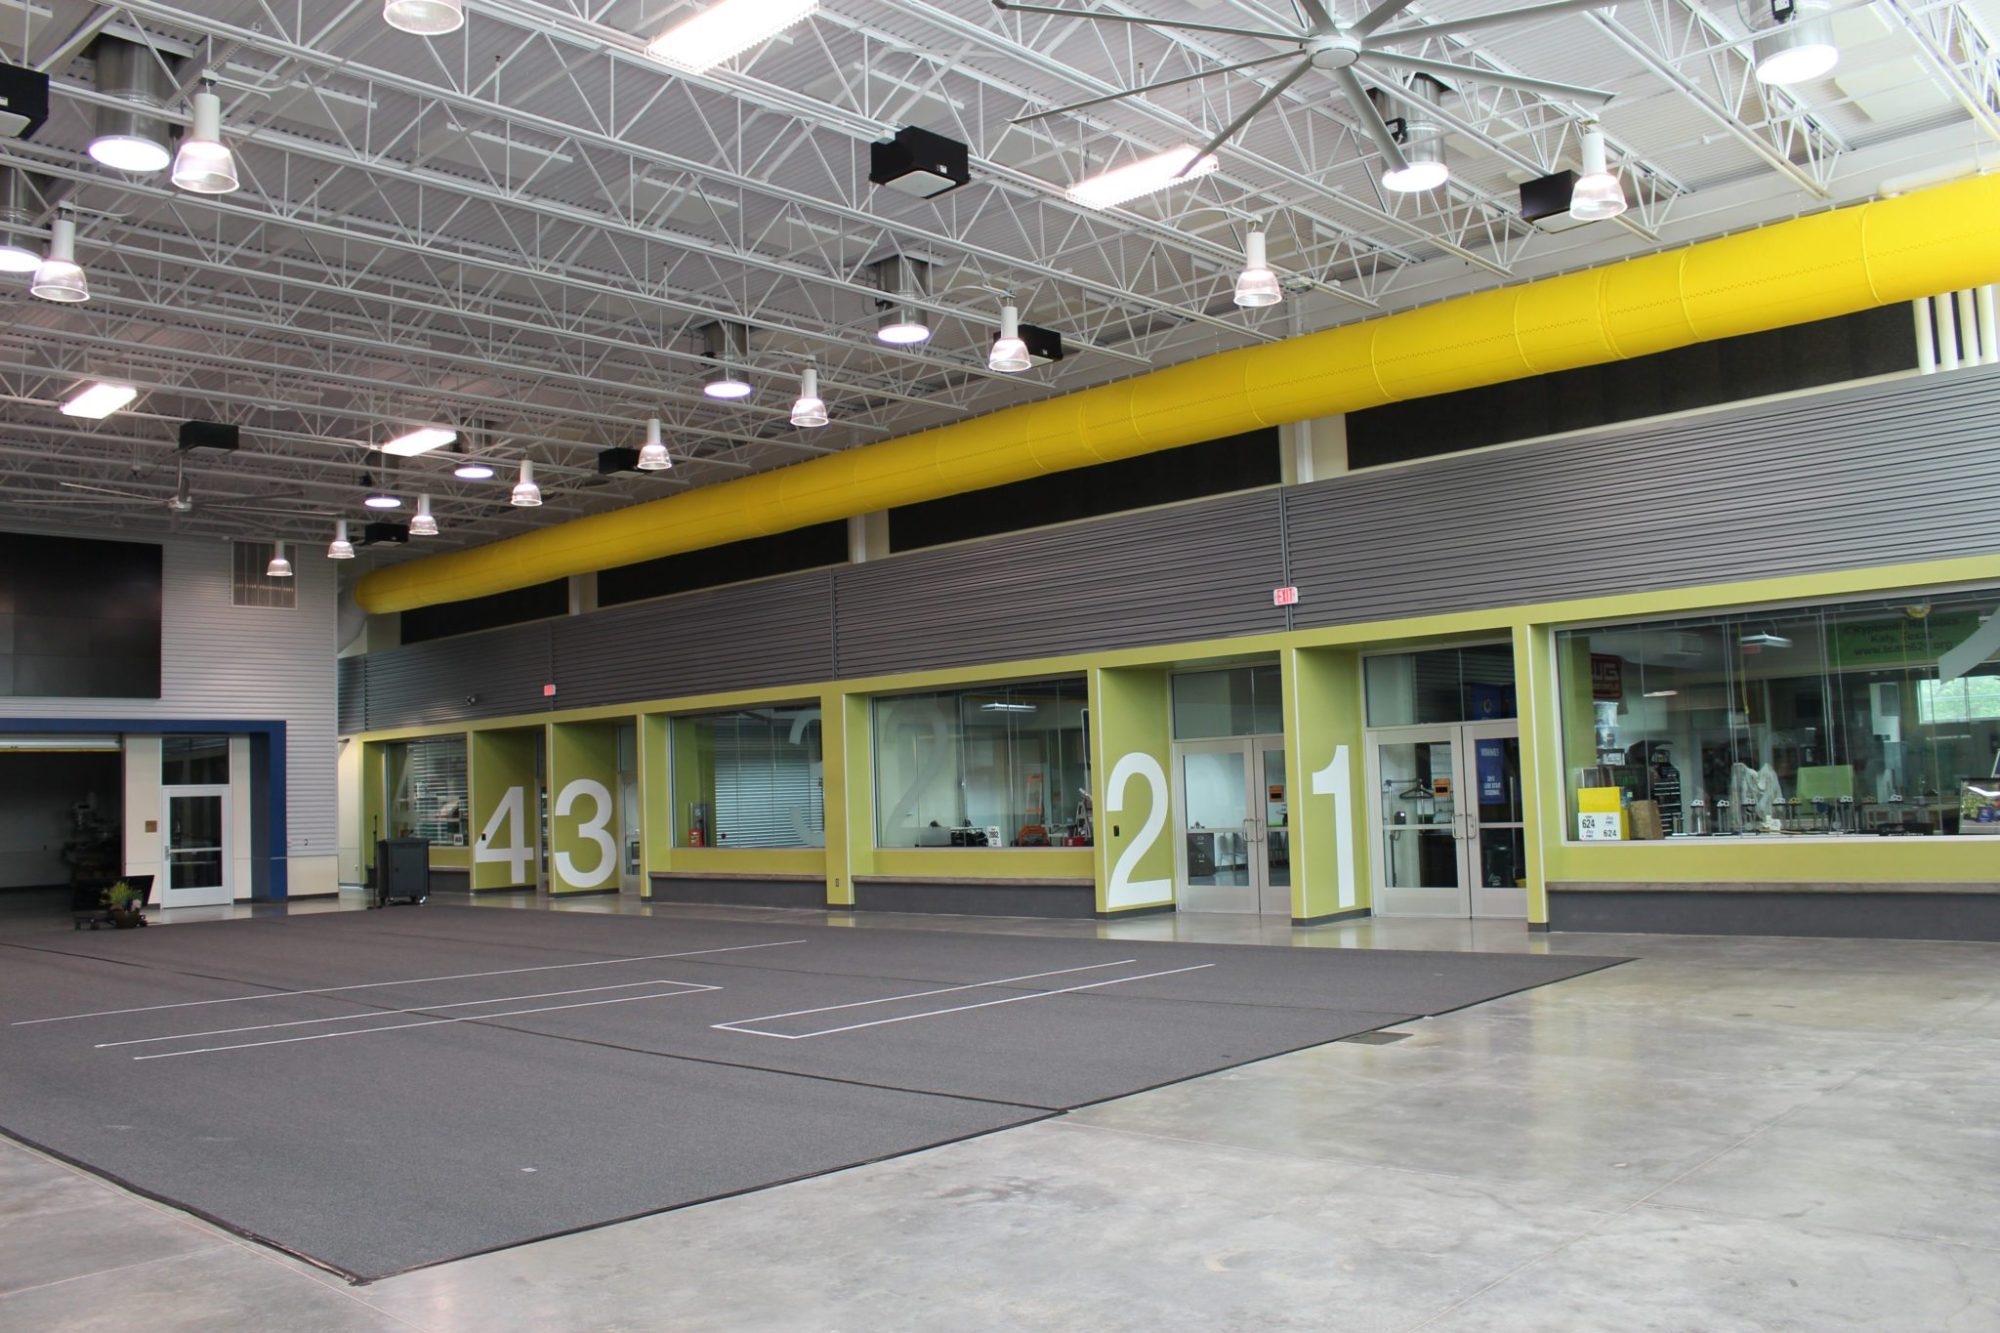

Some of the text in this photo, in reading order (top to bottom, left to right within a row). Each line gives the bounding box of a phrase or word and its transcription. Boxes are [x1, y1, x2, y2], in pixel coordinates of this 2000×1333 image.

[1276, 588, 1293, 603] EXIT
[474, 786, 534, 884] 4
[554, 779, 617, 888] 3
[1106, 752, 1172, 907] 2
[1312, 745, 1355, 907] 1
[1582, 819, 1595, 828] 624
